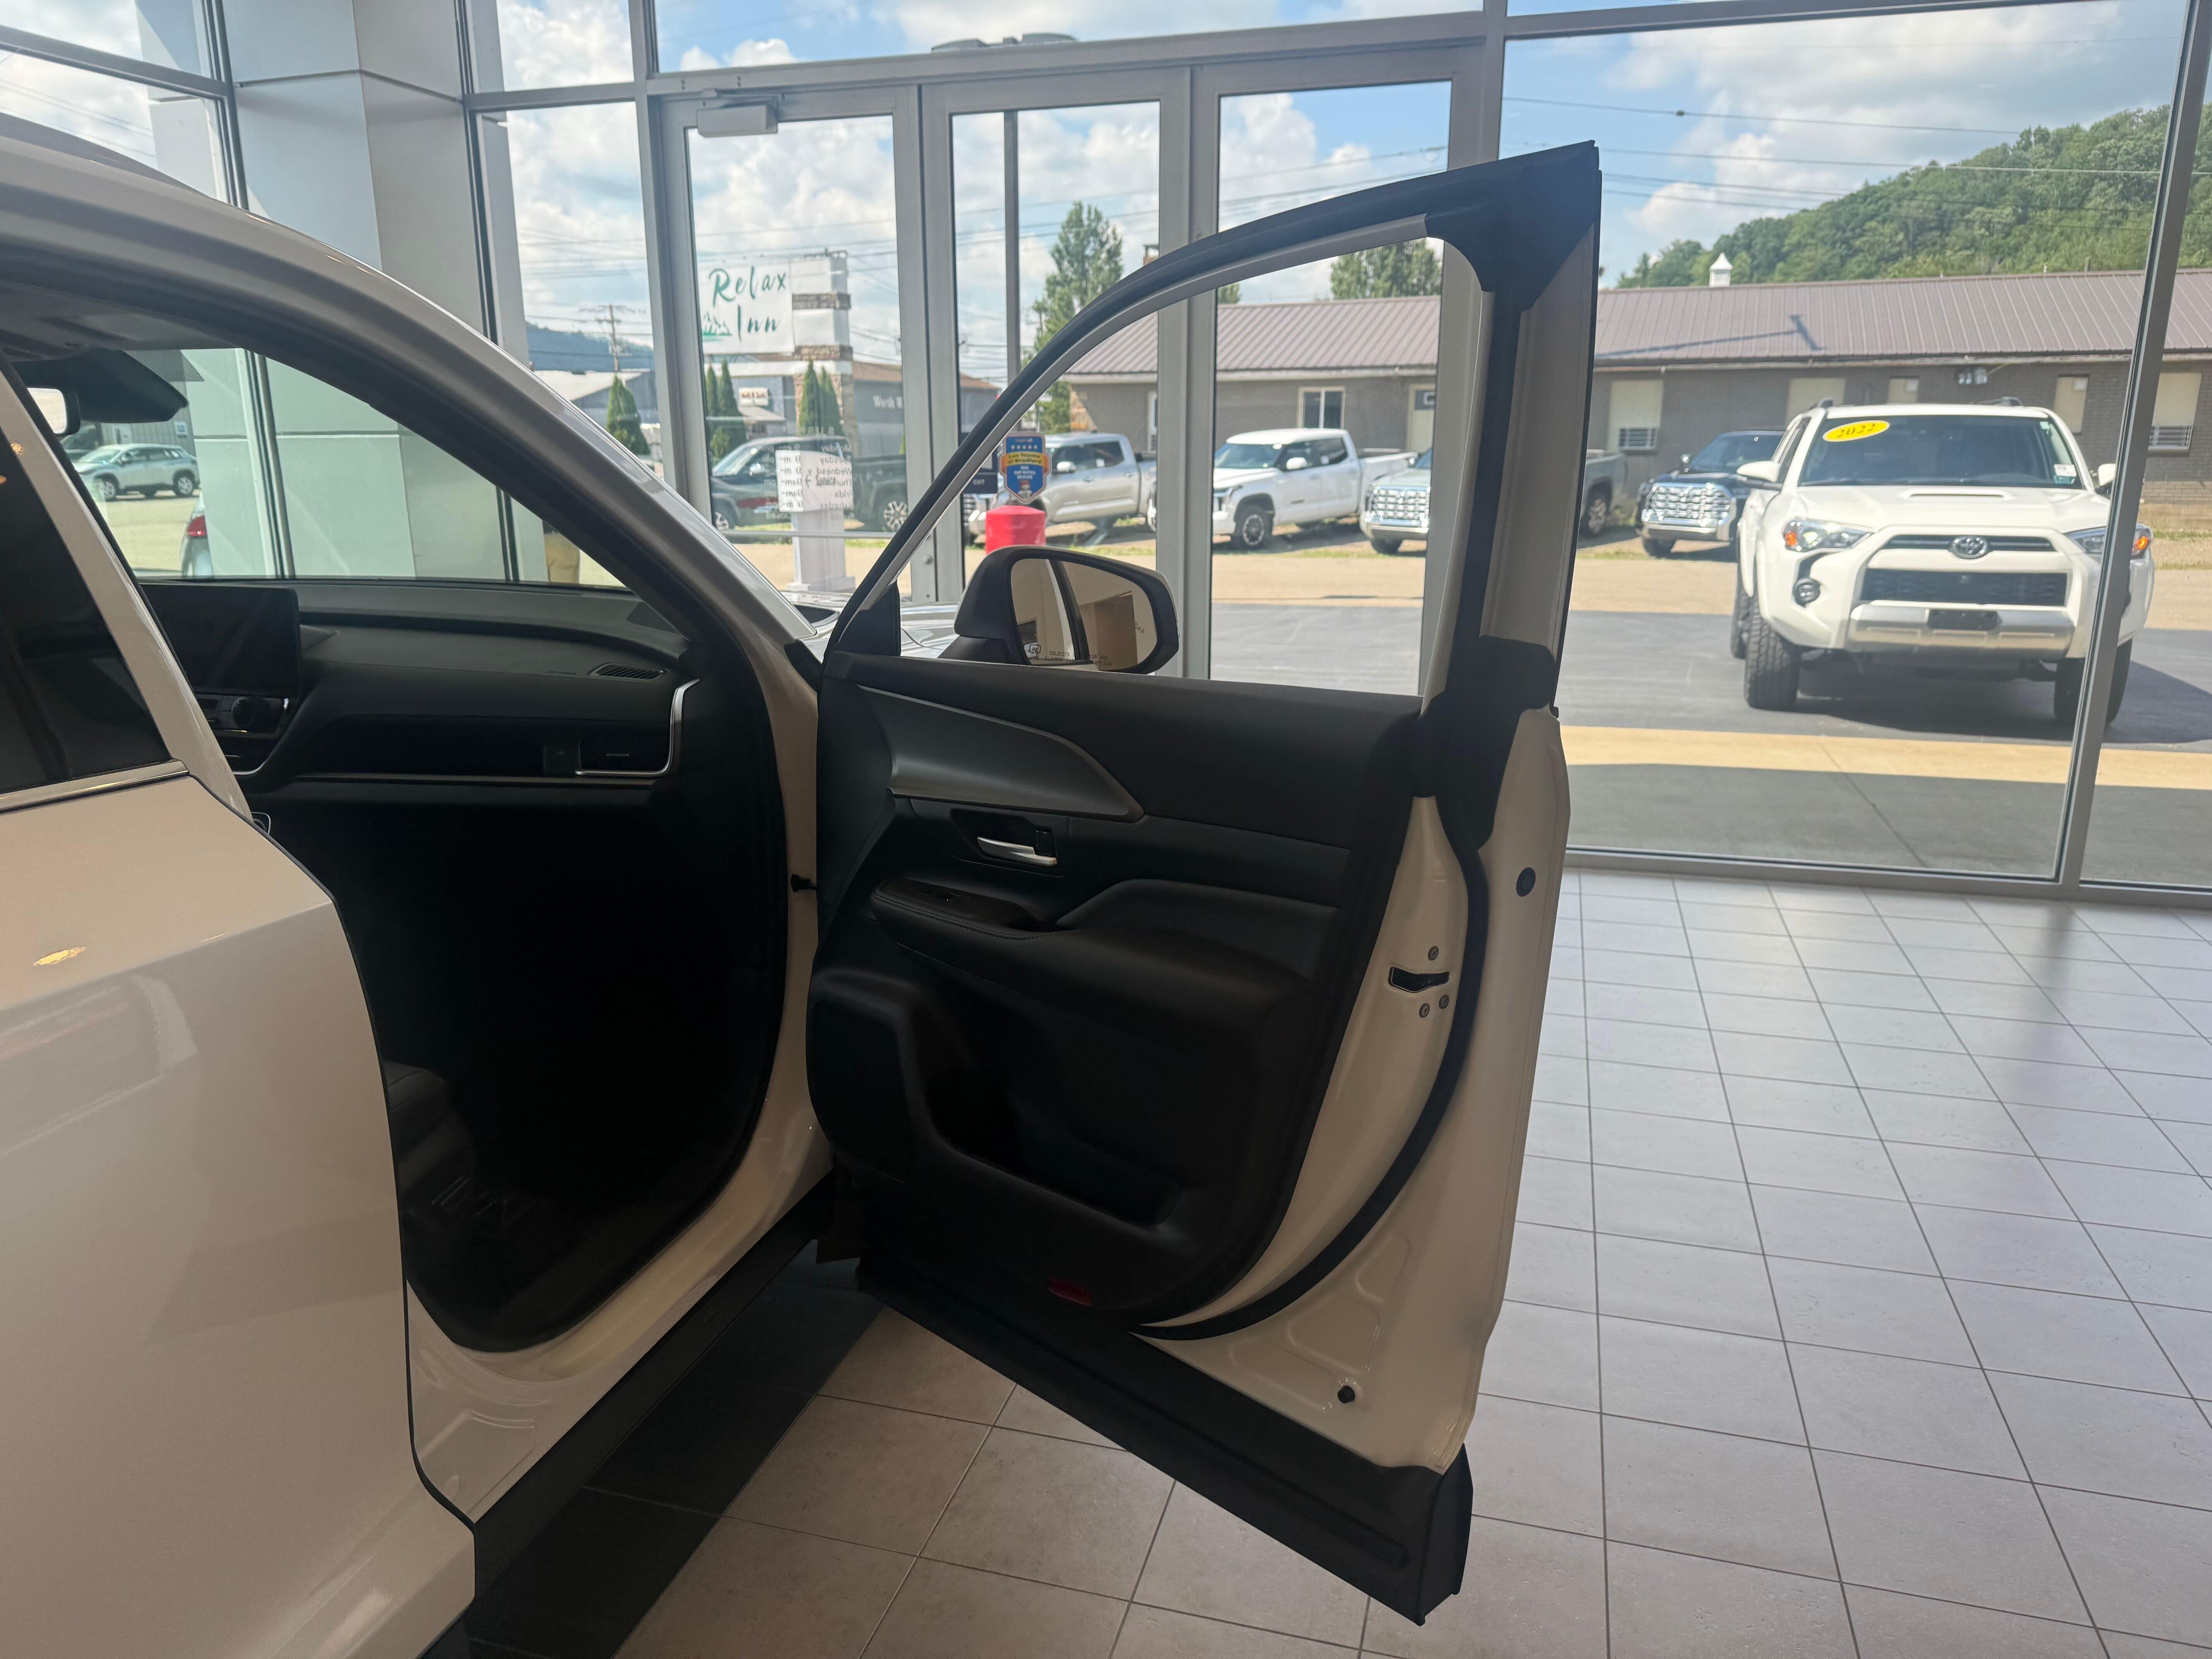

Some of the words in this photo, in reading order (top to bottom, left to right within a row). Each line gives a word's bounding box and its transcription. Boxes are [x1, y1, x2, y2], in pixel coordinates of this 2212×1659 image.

[709, 265, 787, 307] Relax
[738, 304, 781, 341] Inn
[1834, 423, 1875, 438] 2022
